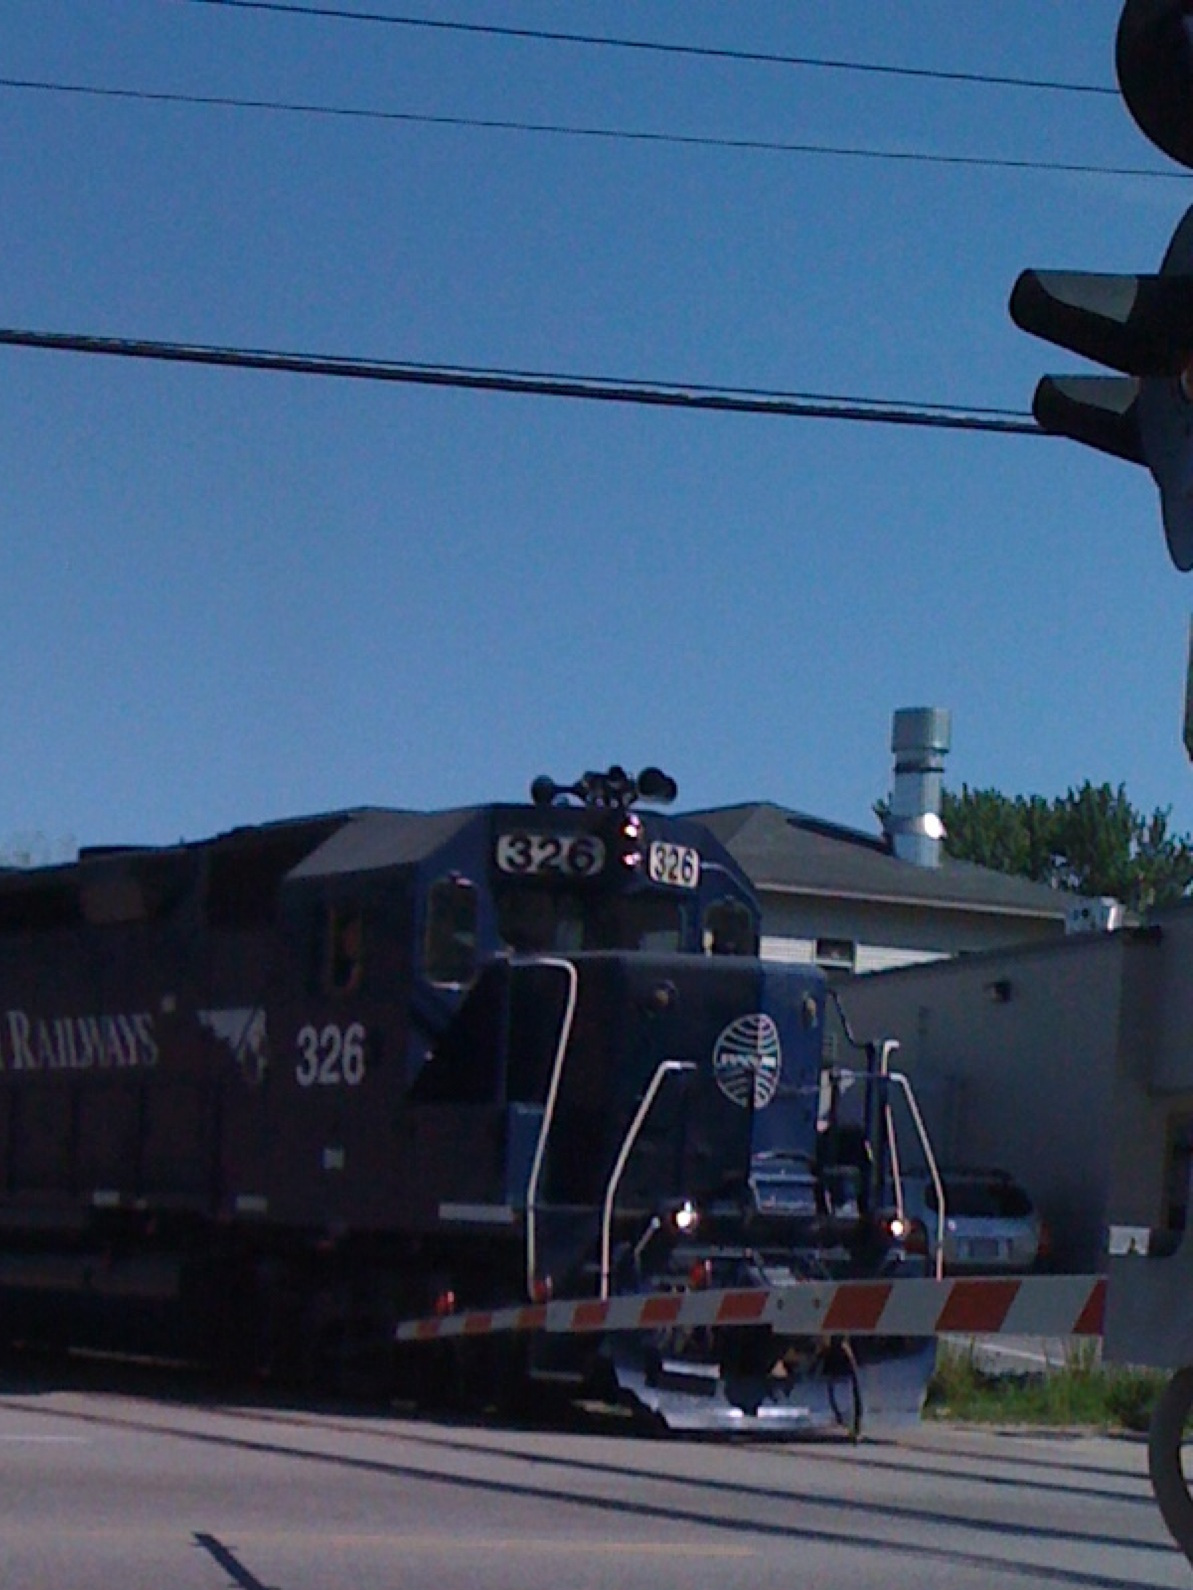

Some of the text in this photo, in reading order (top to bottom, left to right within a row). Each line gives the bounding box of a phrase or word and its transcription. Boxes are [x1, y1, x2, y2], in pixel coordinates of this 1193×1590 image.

[506, 836, 596, 874] 326
[654, 842, 694, 883] 326
[295, 1023, 367, 1087] 326
